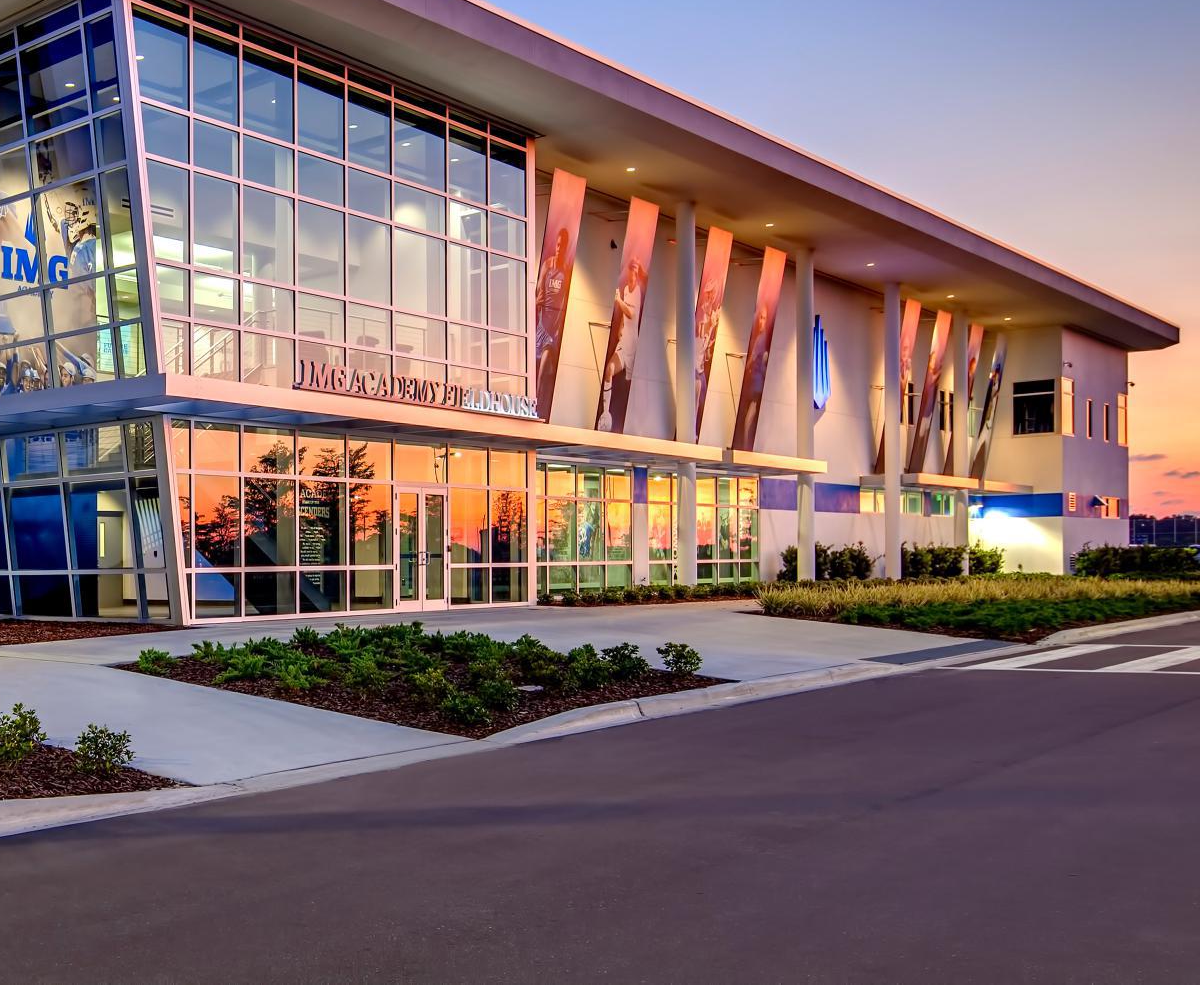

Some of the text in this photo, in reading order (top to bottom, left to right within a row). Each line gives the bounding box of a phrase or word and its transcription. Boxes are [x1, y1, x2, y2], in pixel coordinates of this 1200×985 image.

[1, 246, 69, 290] IMG
[299, 359, 538, 418] IMG ACADEMY FIELDHOUSE
